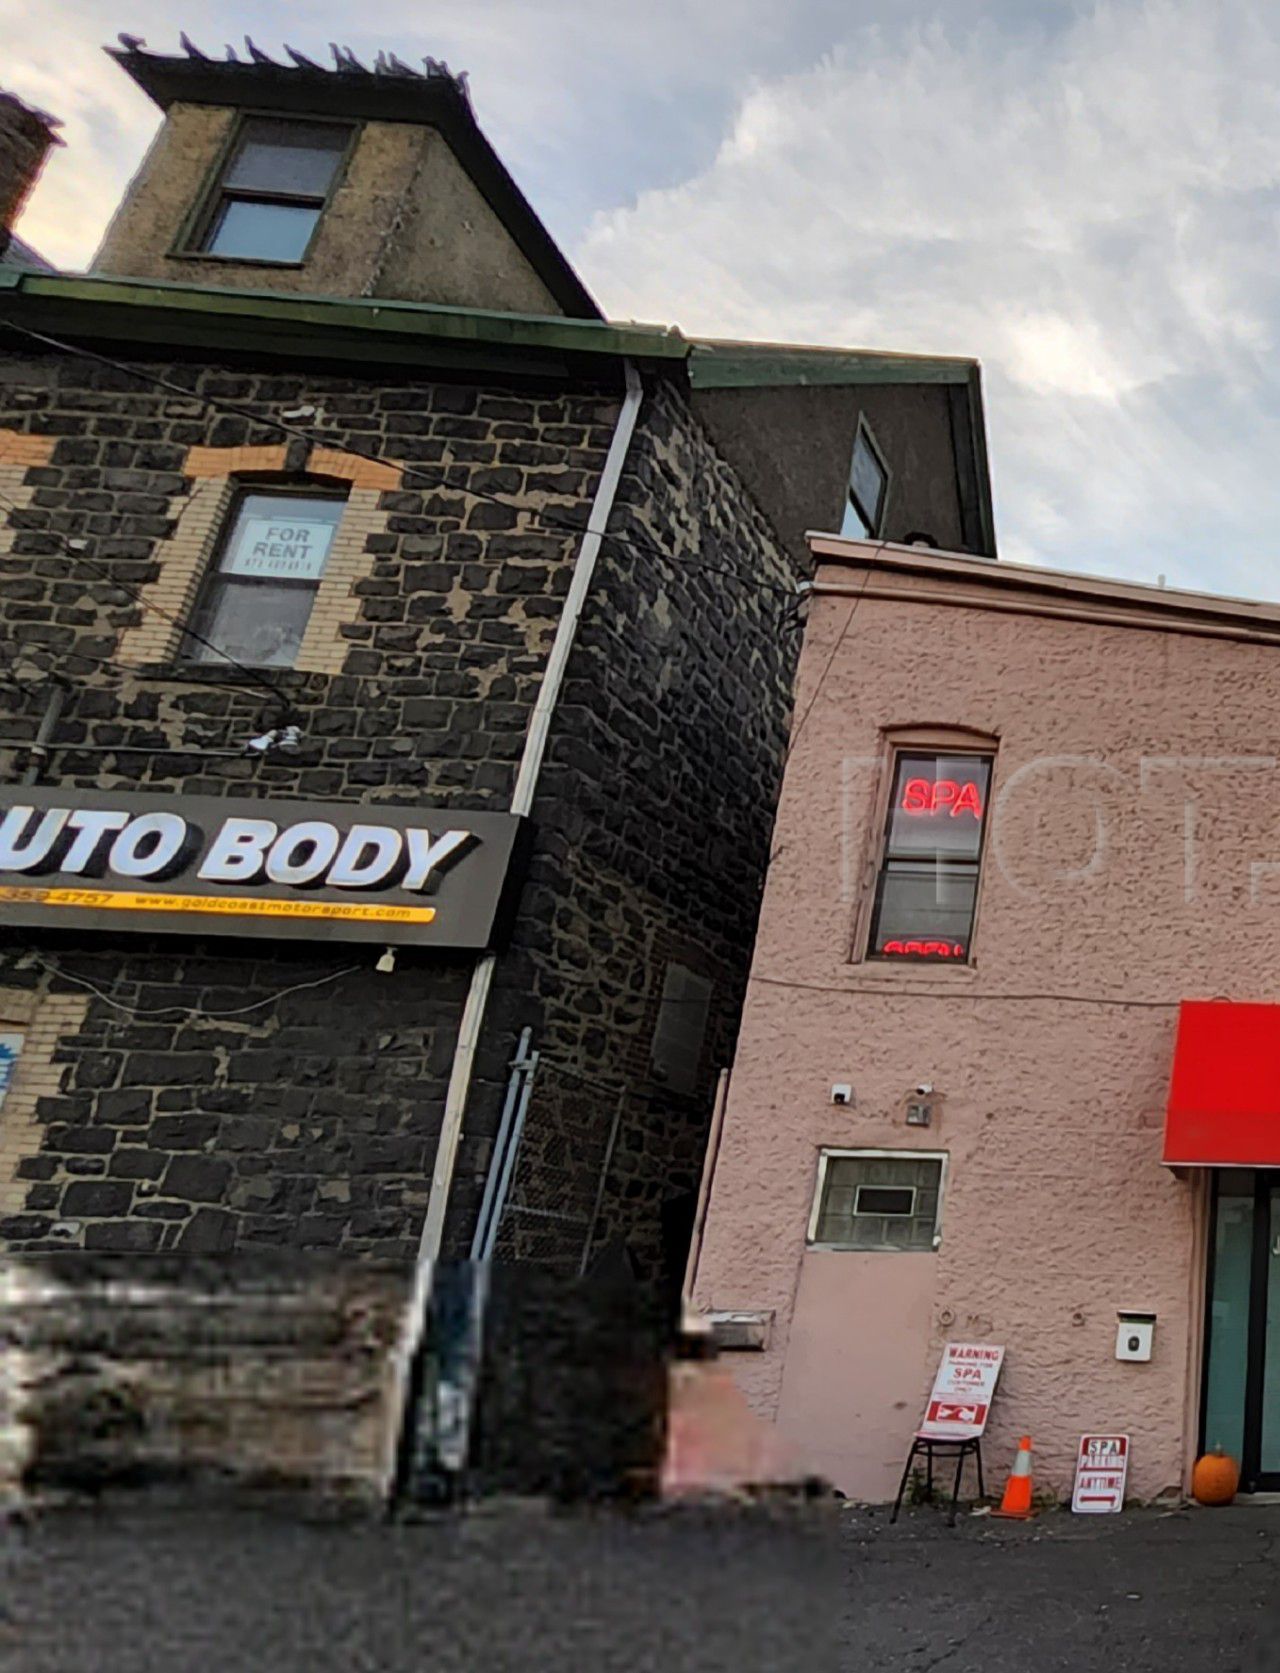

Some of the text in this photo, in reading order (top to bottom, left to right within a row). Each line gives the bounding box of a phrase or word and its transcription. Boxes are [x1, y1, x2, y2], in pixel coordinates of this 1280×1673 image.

[265, 527, 310, 543] FOR
[252, 541, 313, 560] RENT
[902, 778, 983, 820] SPA
[0, 805, 471, 890] UTO BODY
[949, 1347, 999, 1361] WARNING
[953, 1367, 982, 1380] SPA
[1090, 1440, 1119, 1456] SPA
